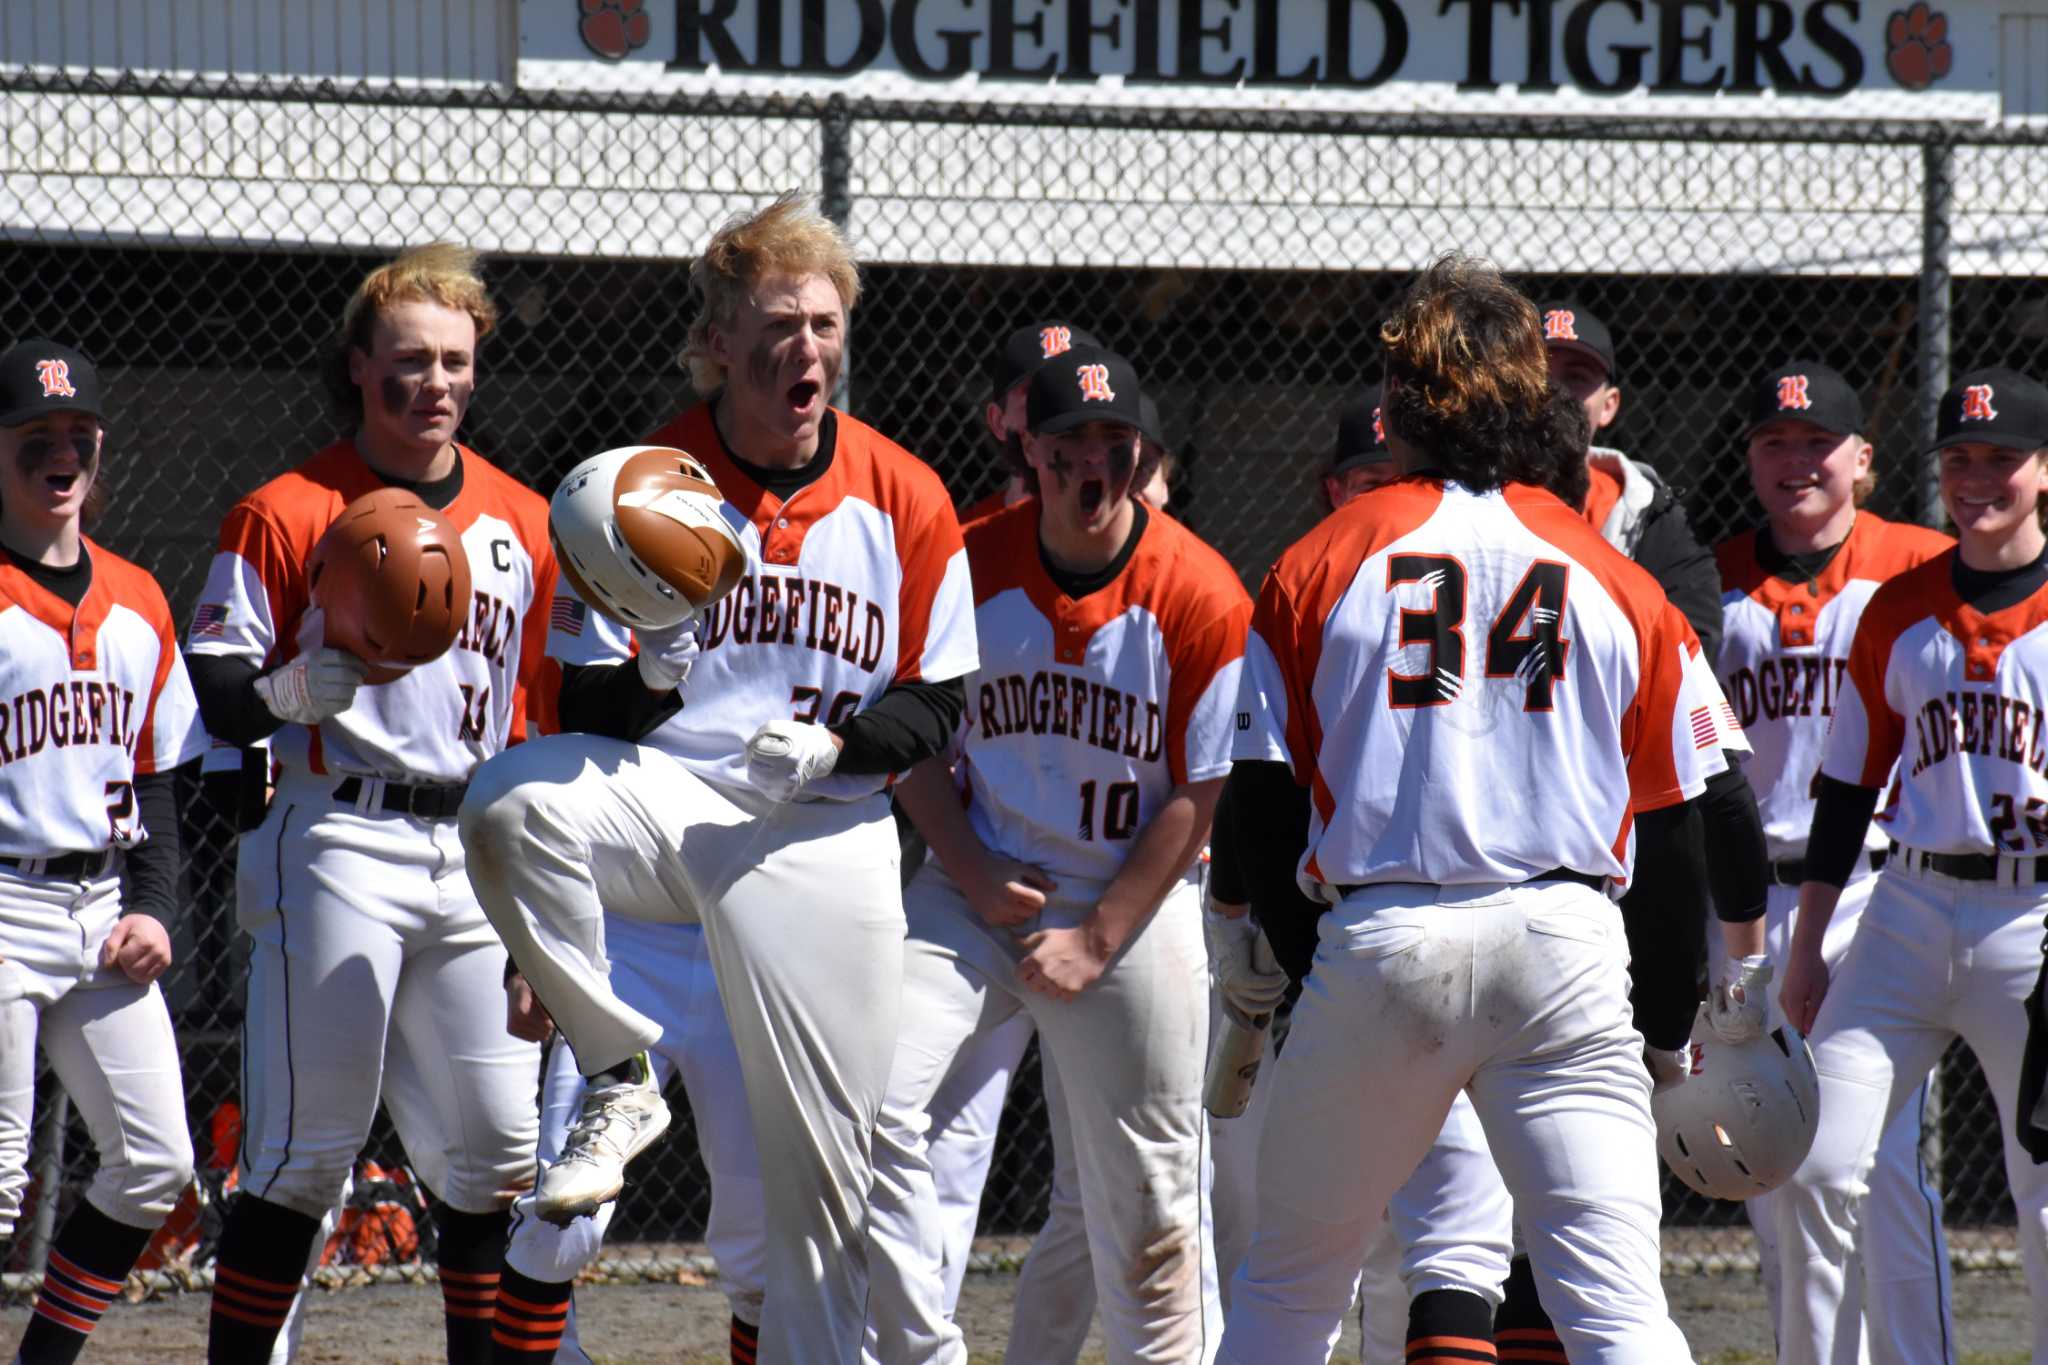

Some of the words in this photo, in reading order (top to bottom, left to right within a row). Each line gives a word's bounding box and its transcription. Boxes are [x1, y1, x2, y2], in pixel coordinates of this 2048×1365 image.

[664, 0, 1409, 88] RIDGEFIELD
[1437, 0, 1865, 98] TIGERS
[36, 359, 76, 398] R
[1077, 364, 1115, 402] R
[1777, 374, 1812, 410] R
[1960, 384, 1998, 422] R
[490, 539, 511, 573] C
[1386, 552, 1570, 713] 34
[979, 671, 1162, 763] RIDGEFIELD
[1078, 780, 1140, 841] 10
